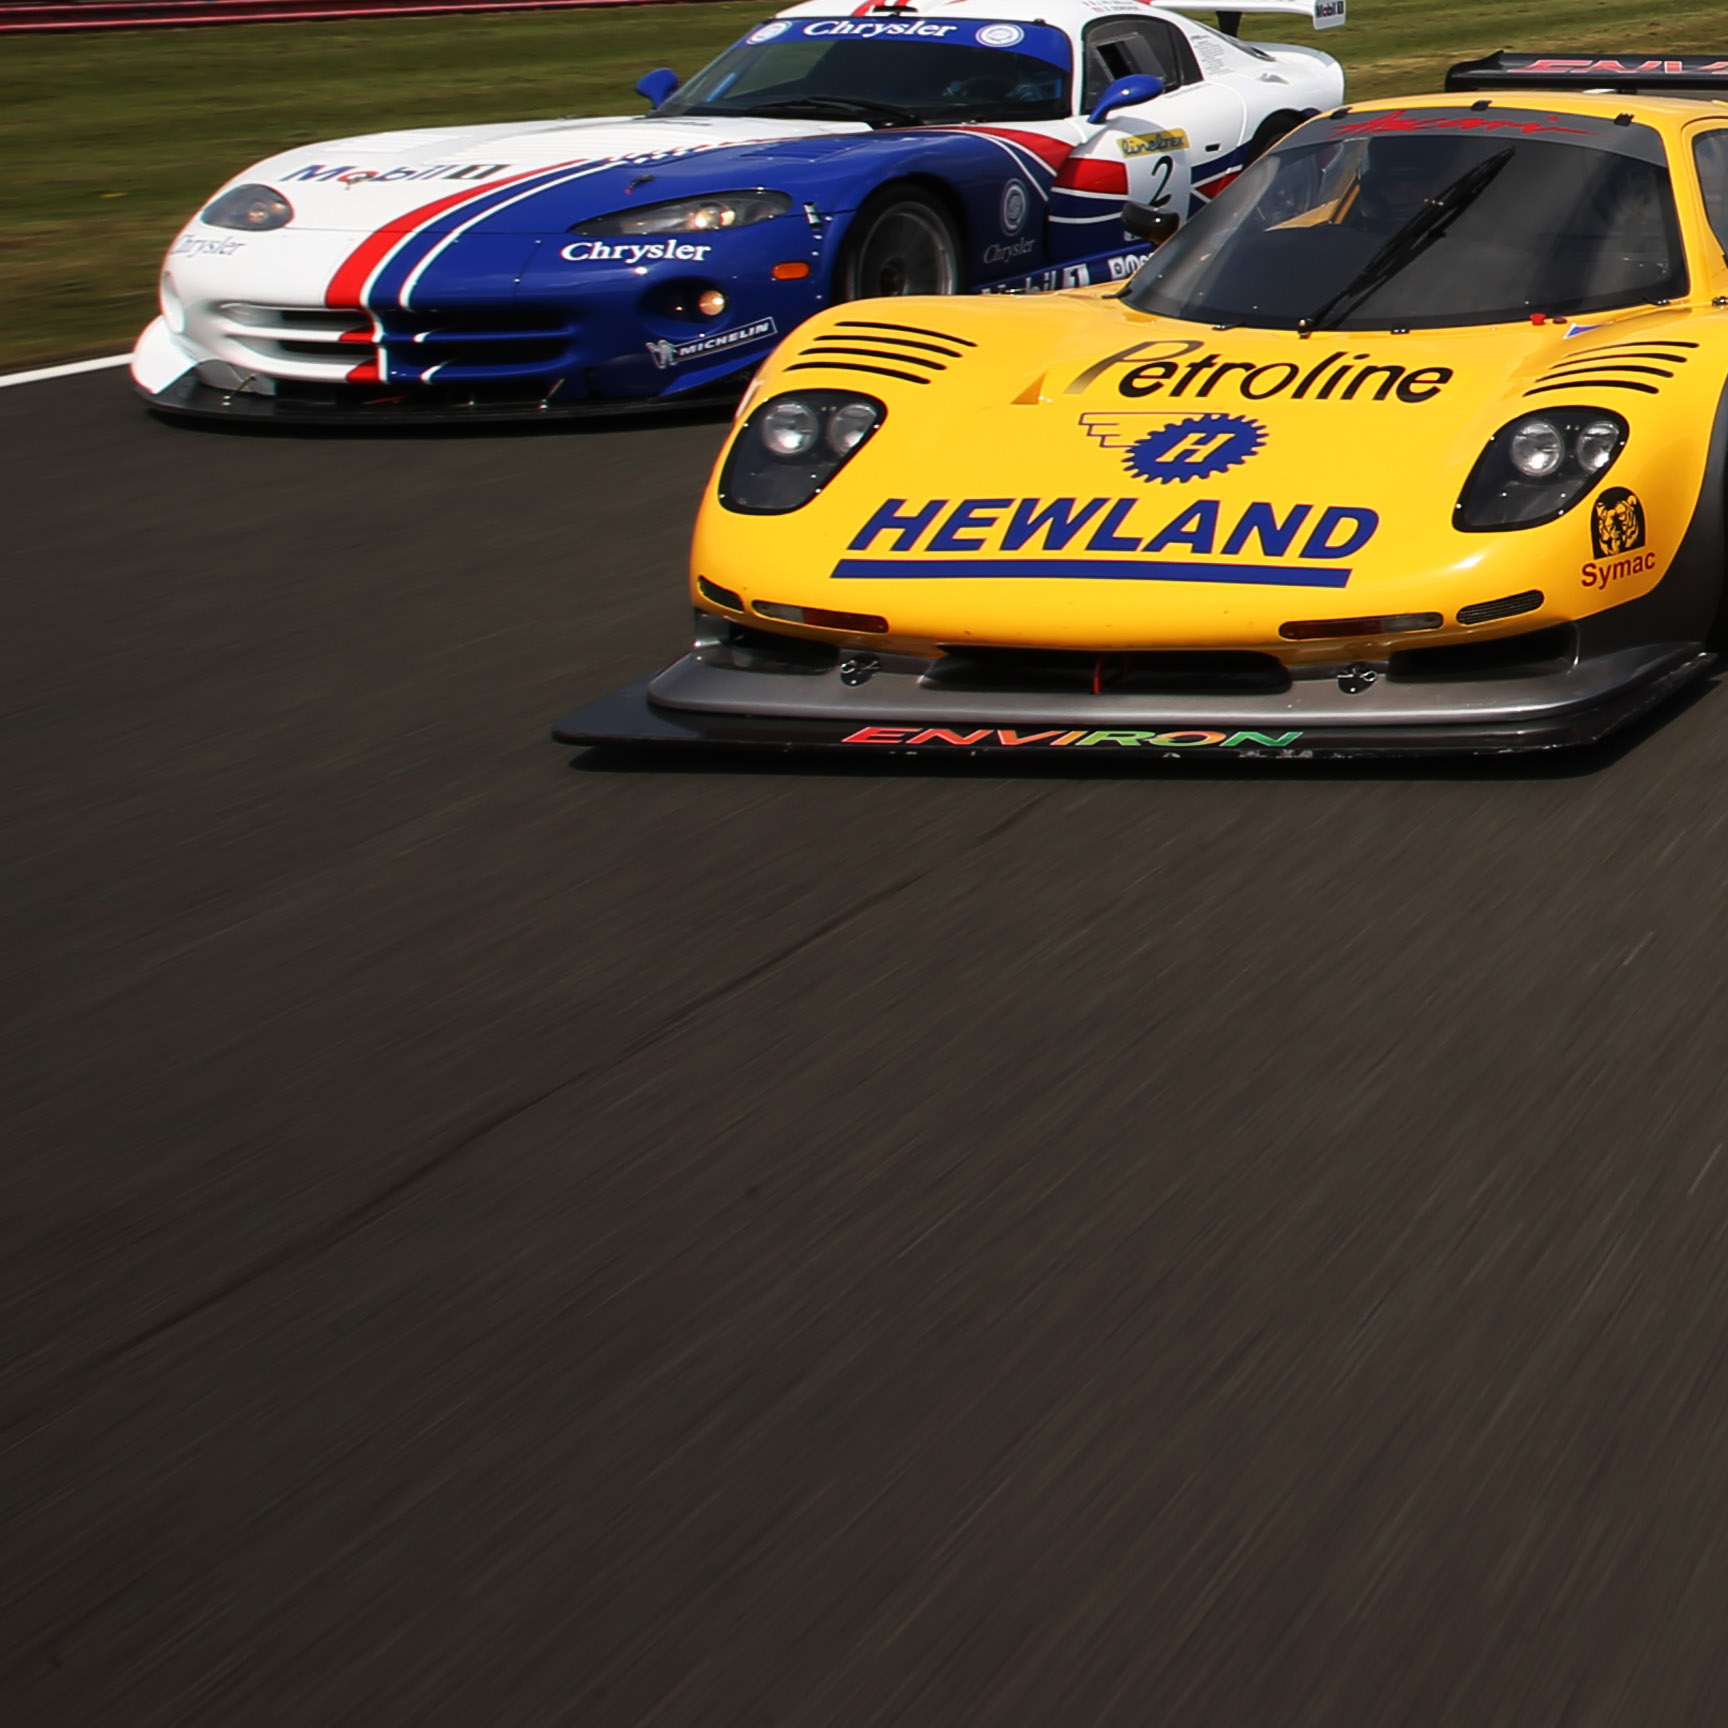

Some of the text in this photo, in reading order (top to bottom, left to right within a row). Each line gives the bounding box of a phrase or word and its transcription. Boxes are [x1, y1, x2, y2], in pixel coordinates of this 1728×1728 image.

[803, 20, 957, 37] Chrysler
[279, 164, 450, 182] Mobil
[1148, 155, 1173, 207] 2
[561, 239, 711, 263] Chrysler
[983, 237, 1036, 264] Chrysler
[678, 322, 769, 356] MICHELIN
[1063, 340, 1454, 403] Petroline
[1155, 433, 1237, 463] H
[847, 497, 1380, 560] HEWLAND
[1581, 552, 1656, 590] Symac
[841, 726, 1303, 747] ENVIRON
